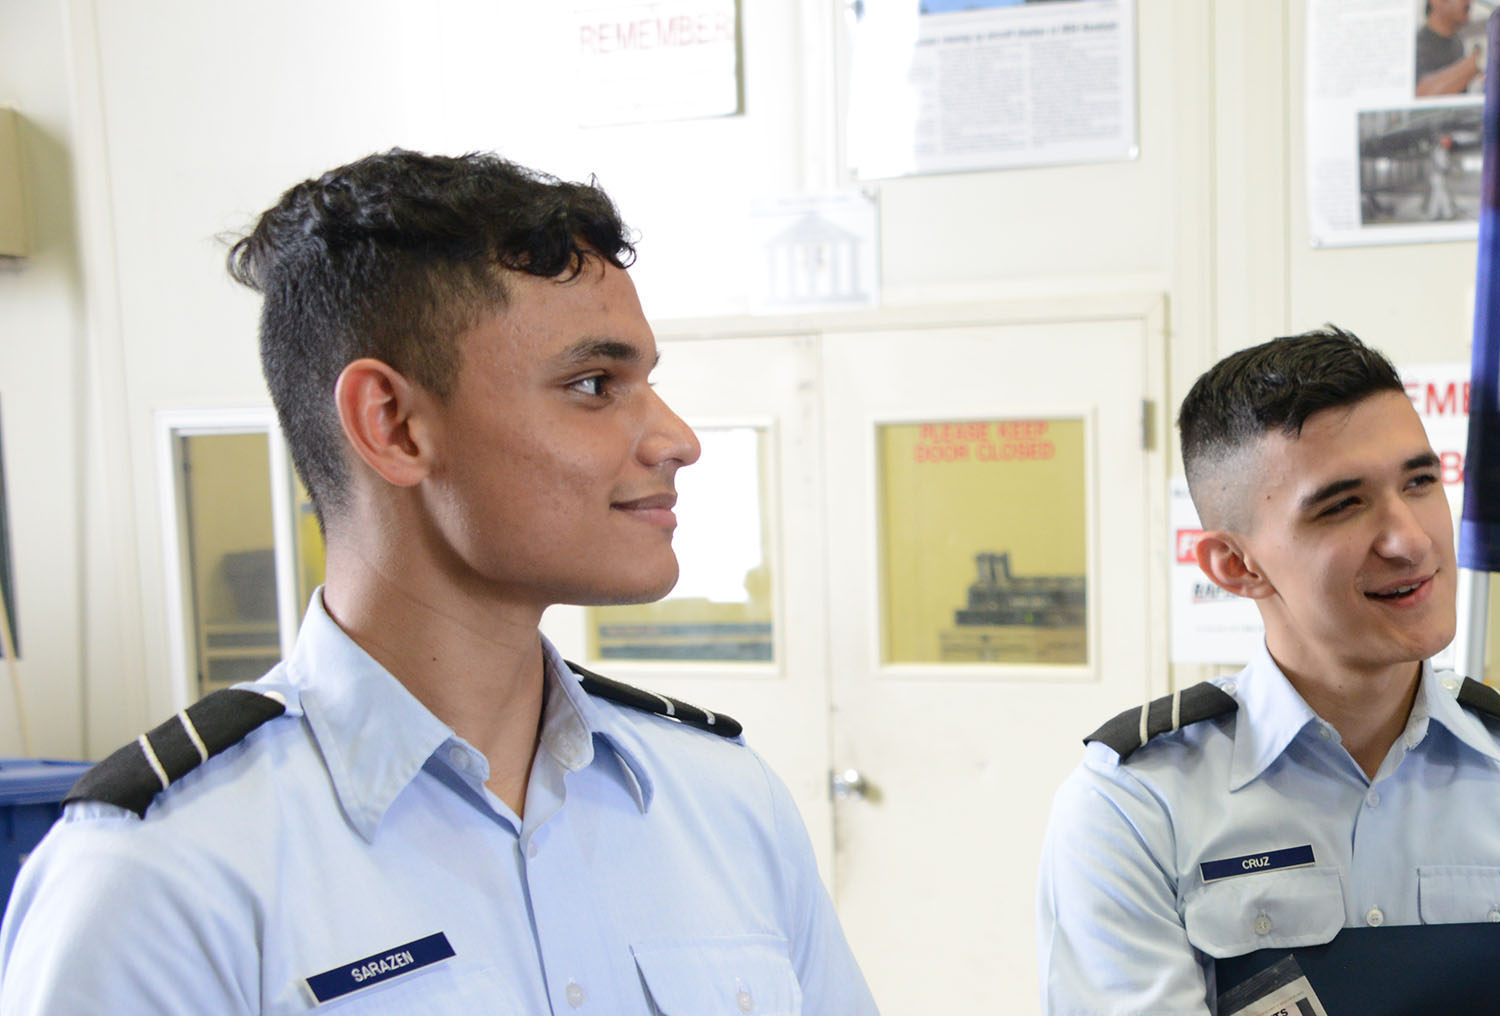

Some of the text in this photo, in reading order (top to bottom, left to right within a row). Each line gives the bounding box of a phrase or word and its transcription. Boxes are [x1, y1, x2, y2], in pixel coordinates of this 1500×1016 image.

[579, 11, 732, 55] REMEMBER
[1242, 856, 1271, 870] CRUZ
[351, 950, 415, 983] SARAZEN
